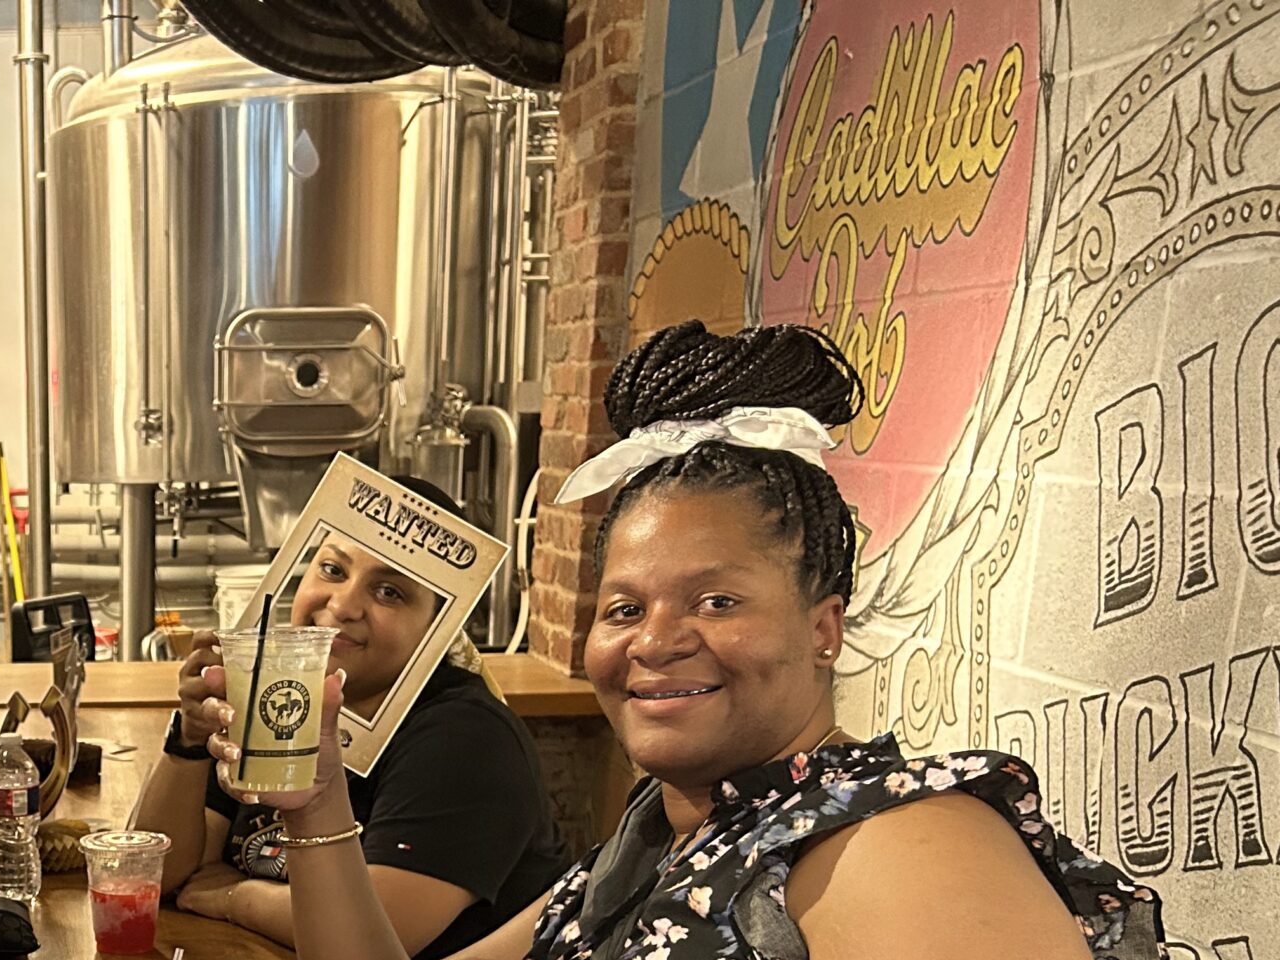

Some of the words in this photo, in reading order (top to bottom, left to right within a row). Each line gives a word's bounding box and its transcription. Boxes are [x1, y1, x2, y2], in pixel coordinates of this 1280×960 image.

[773, 9, 1024, 252] Cadillac
[348, 477, 477, 570] WANTED
[261, 681, 289, 702] SECOND
[291, 681, 310, 701] RODEO
[268, 720, 302, 733] BREWING
[995, 645, 1280, 877] UCK
